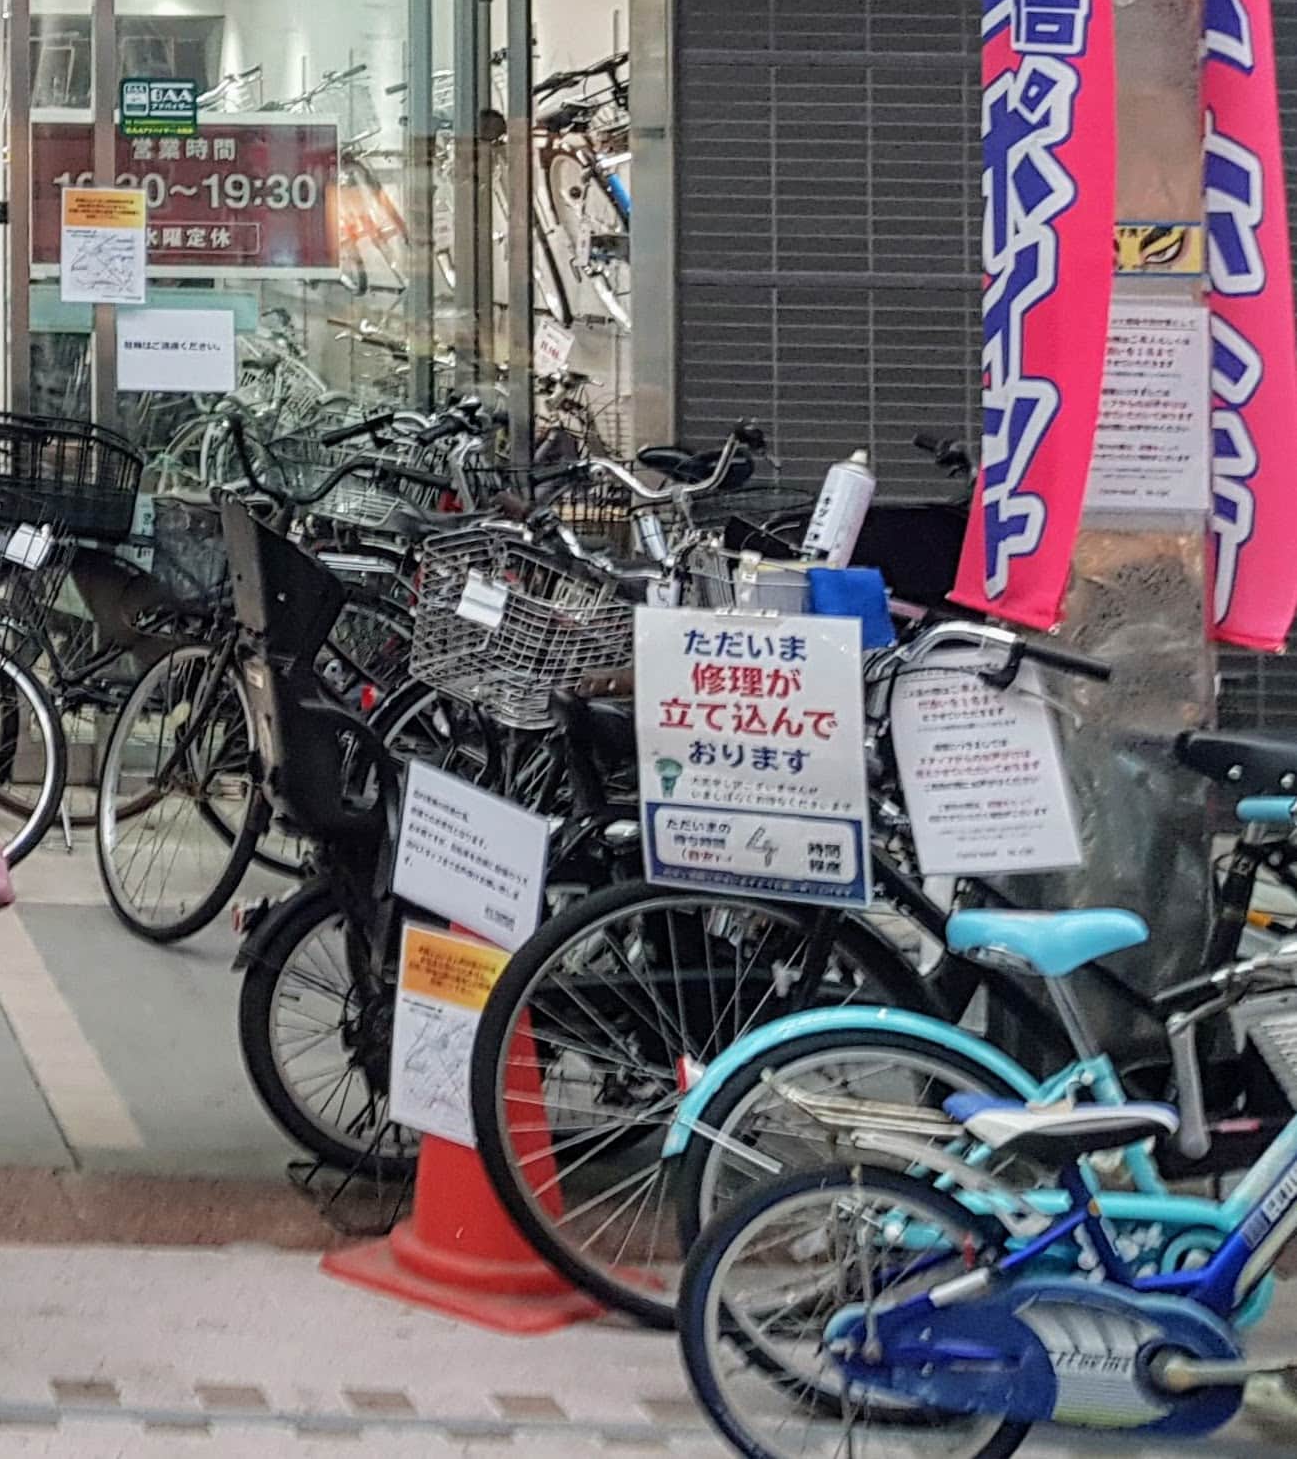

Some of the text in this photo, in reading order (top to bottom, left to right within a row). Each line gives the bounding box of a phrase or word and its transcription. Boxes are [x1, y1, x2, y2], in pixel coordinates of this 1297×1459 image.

[132, 137, 236, 161] 営業時間
[683, 629, 808, 661] ただいま
[691, 663, 802, 699] 修理が
[659, 697, 838, 740] 立て込んで
[688, 740, 810, 774] おります
[665, 817, 732, 834] ただいまの
[807, 841, 841, 859] 時間
